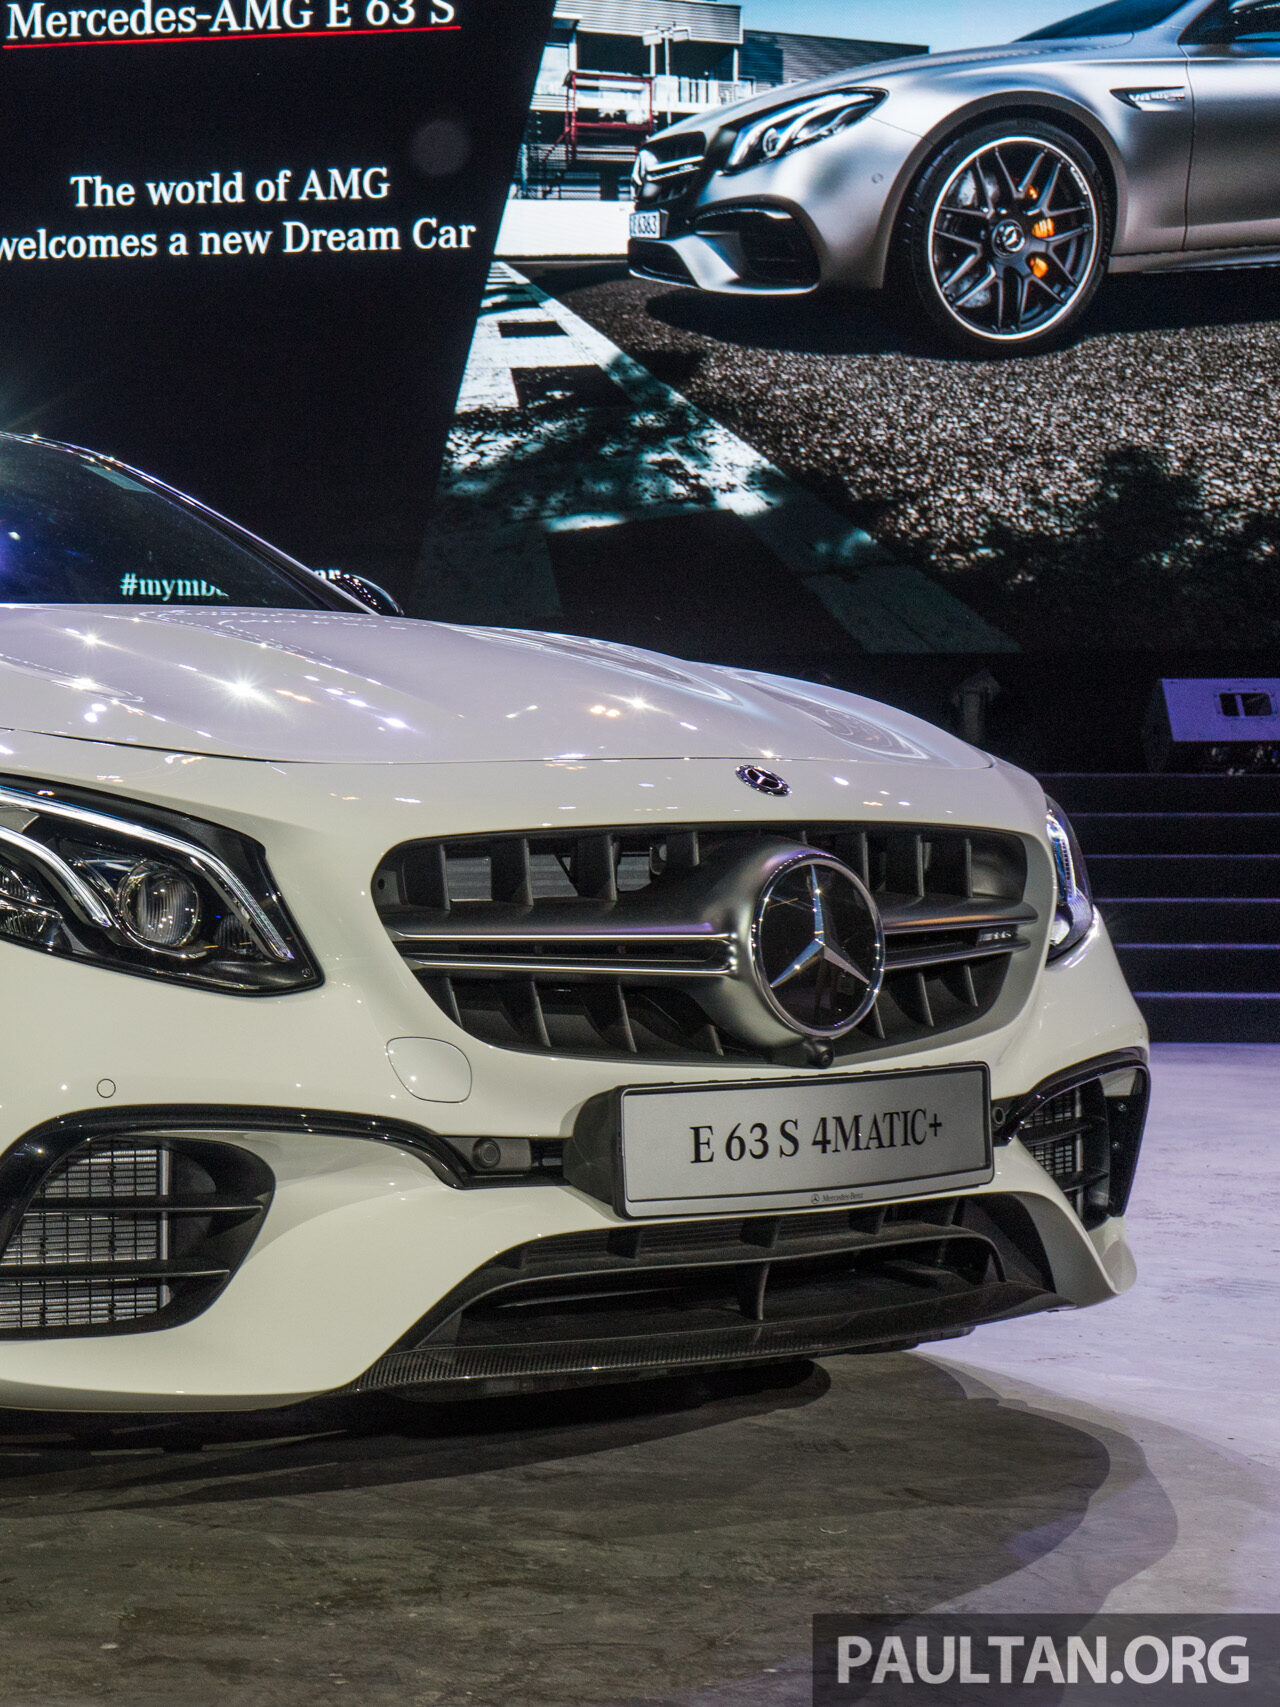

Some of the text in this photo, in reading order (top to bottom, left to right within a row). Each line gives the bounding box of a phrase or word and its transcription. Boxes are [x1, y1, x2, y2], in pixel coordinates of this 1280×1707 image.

[6, 0, 456, 40] Mercedes-AMG E 63 S
[70, 166, 391, 207] The world of AMG
[169, 232, 190, 256] a
[199, 230, 274, 255] new
[282, 219, 402, 253] Dream
[413, 216, 477, 249] Car
[690, 1108, 943, 1164] E 63 S 4MATIC+
